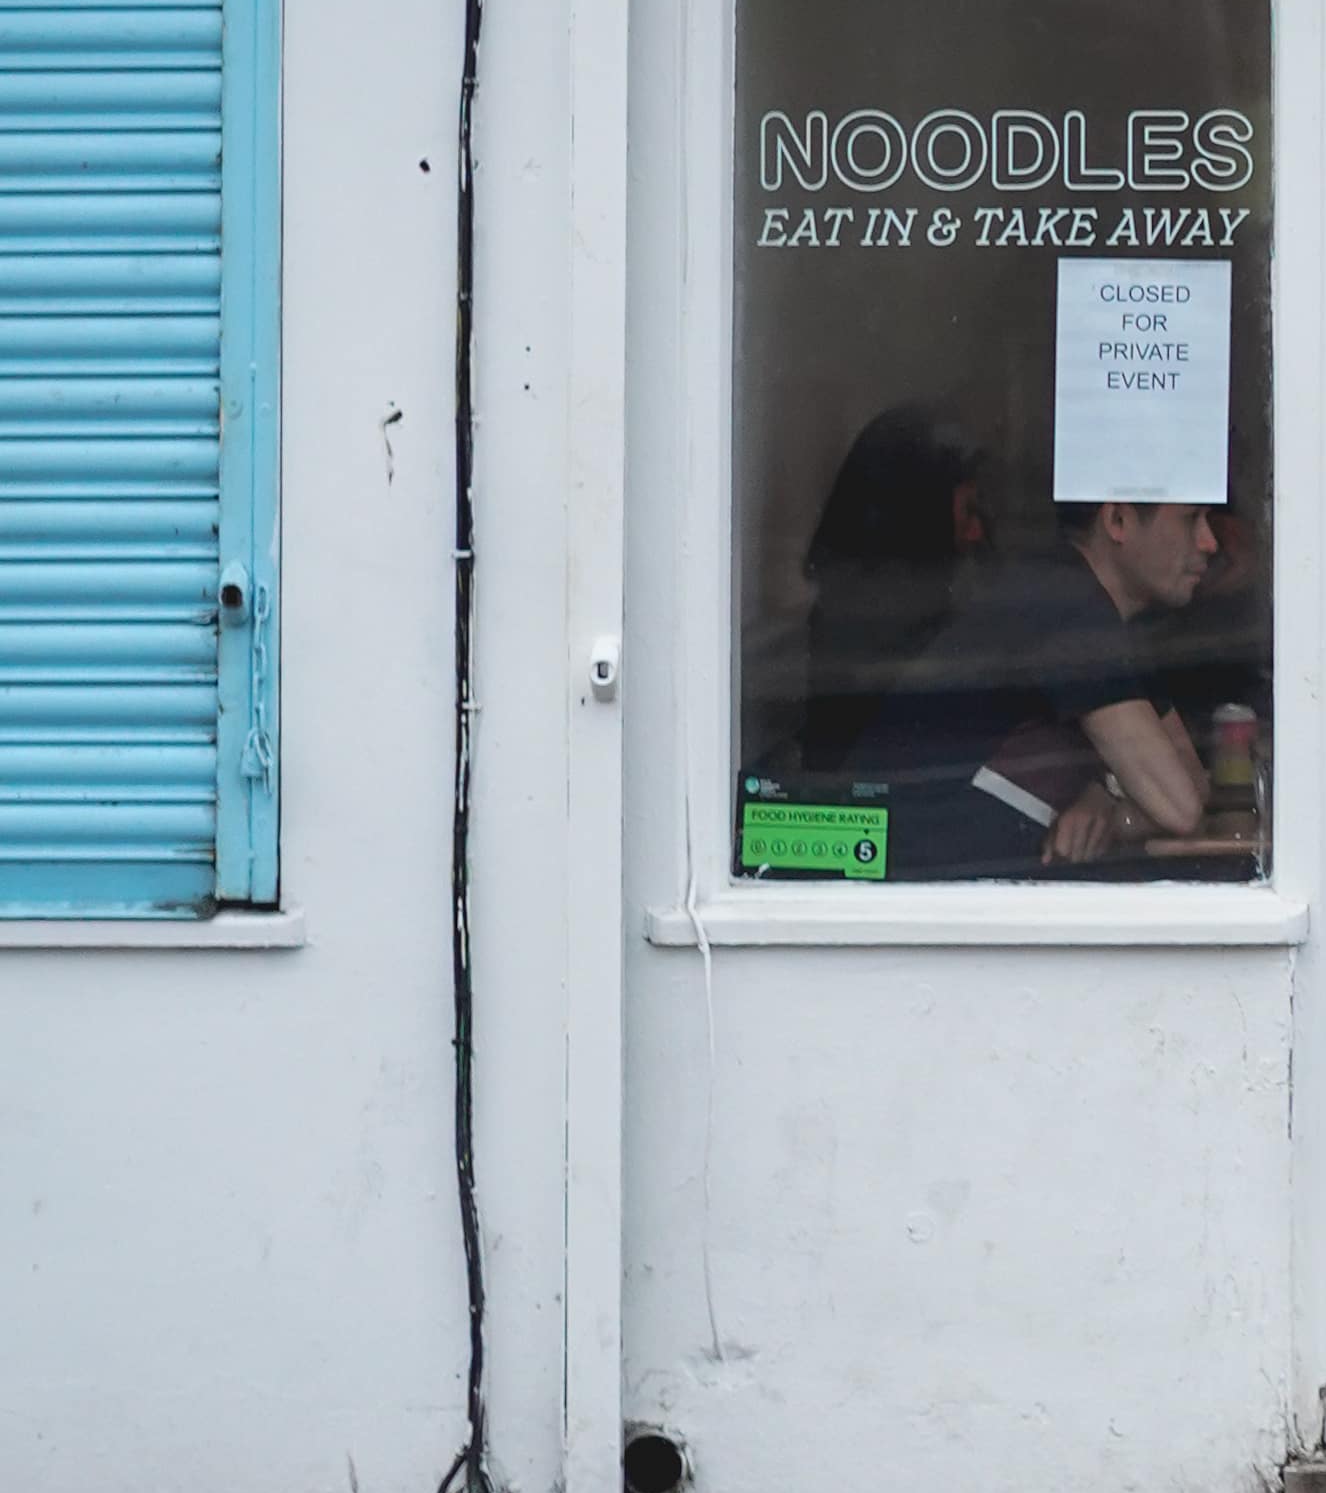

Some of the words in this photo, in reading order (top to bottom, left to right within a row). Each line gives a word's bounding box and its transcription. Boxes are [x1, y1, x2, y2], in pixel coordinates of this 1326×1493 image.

[760, 109, 1254, 192] NOODLES
[757, 208, 853, 247] EAT
[860, 208, 918, 247] IN
[927, 208, 961, 247] &
[974, 208, 1098, 247] TAKE
[1106, 208, 1250, 247] AWAY
[1099, 285, 1191, 304] CLOSED
[1121, 313, 1168, 332] FOR
[1098, 342, 1189, 362] PRIVATE
[1107, 371, 1180, 390] EVENT
[752, 809, 785, 822] FOOD
[788, 811, 836, 824] HYGIENE
[839, 812, 880, 825] RATING
